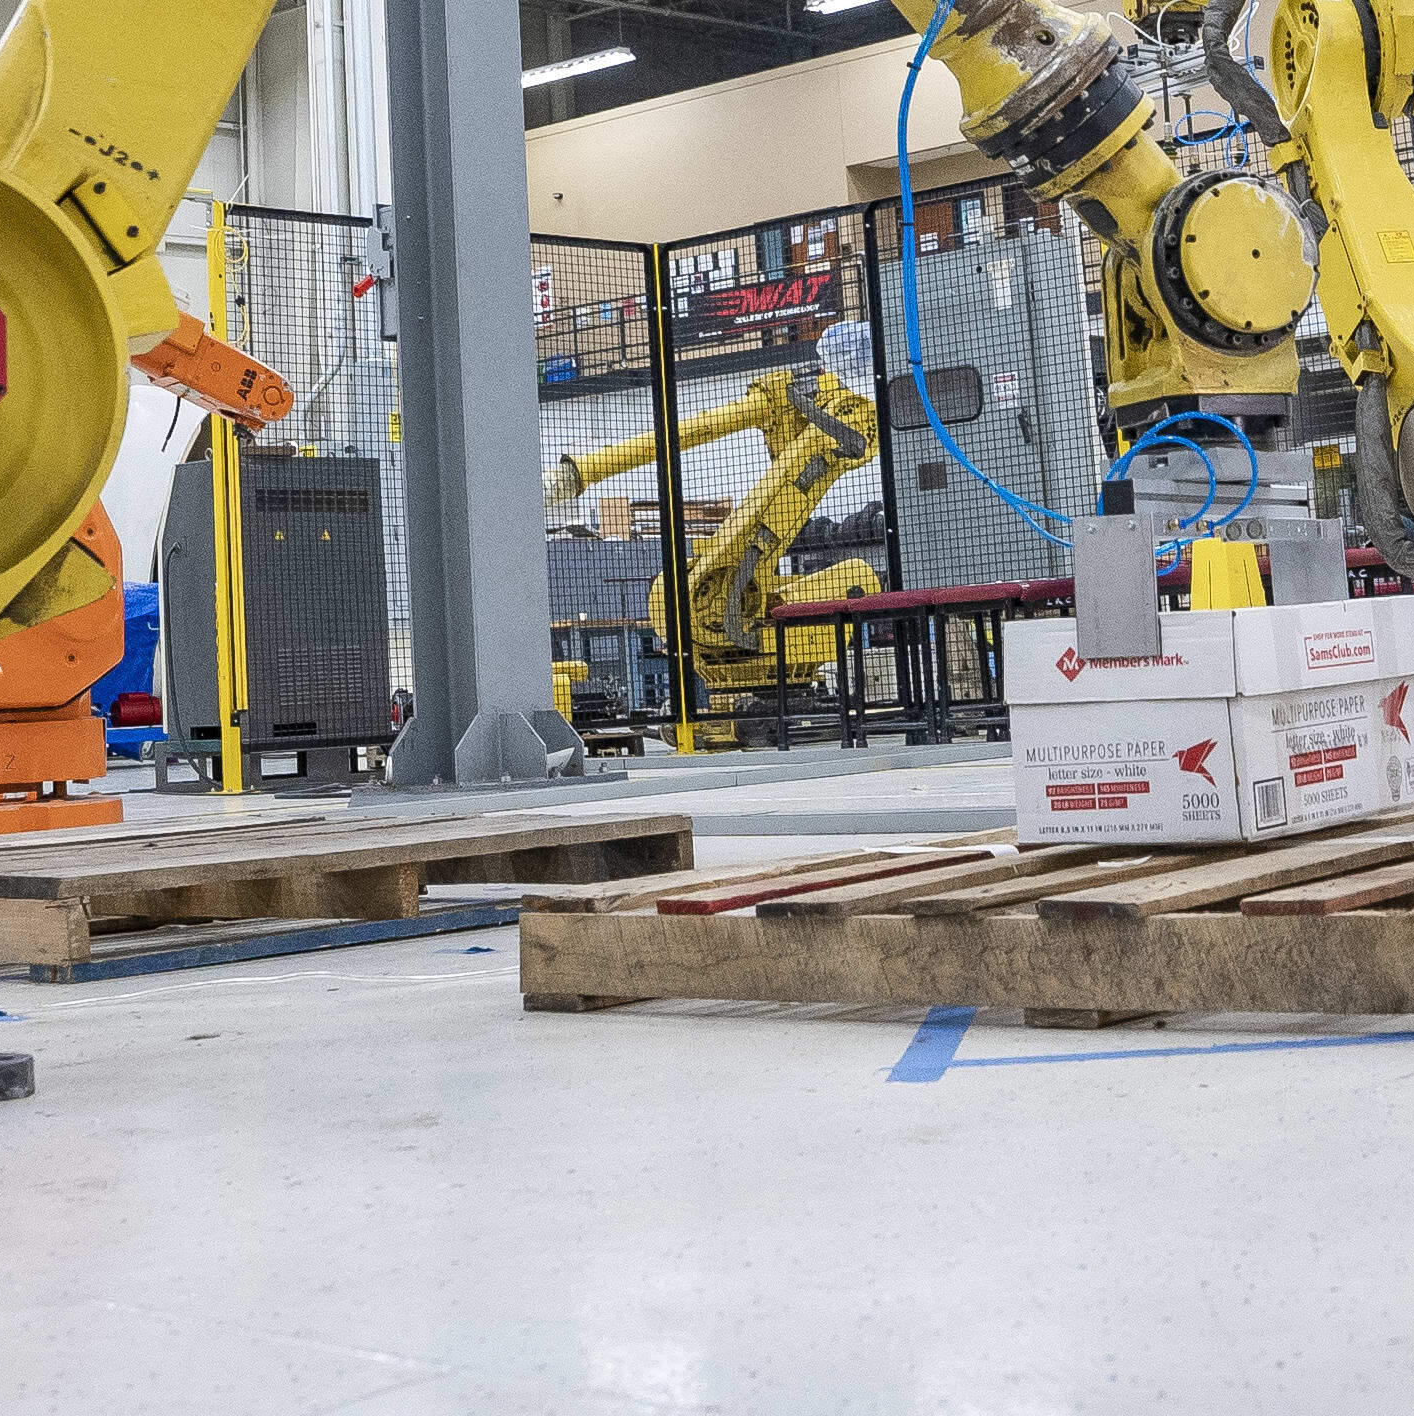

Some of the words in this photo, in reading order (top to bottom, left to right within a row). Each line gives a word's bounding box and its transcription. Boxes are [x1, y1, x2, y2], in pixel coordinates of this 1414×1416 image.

[236, 368, 257, 402] ABB
[1151, 653, 1184, 667] Mark
[1309, 644, 1371, 661] SamsClub.com
[1271, 699, 1338, 726] MULTIPURPOSE
[1339, 694, 1365, 715] PAPER
[1025, 743, 1122, 763] MULTIPURPOSE
[1127, 740, 1166, 758] PAPER
[1048, 767, 1077, 781] letter
[1081, 767, 1103, 779] size
[1114, 764, 1147, 778] white
[1182, 792, 1220, 809] 5000
[1182, 809, 1221, 822] SHEETS
